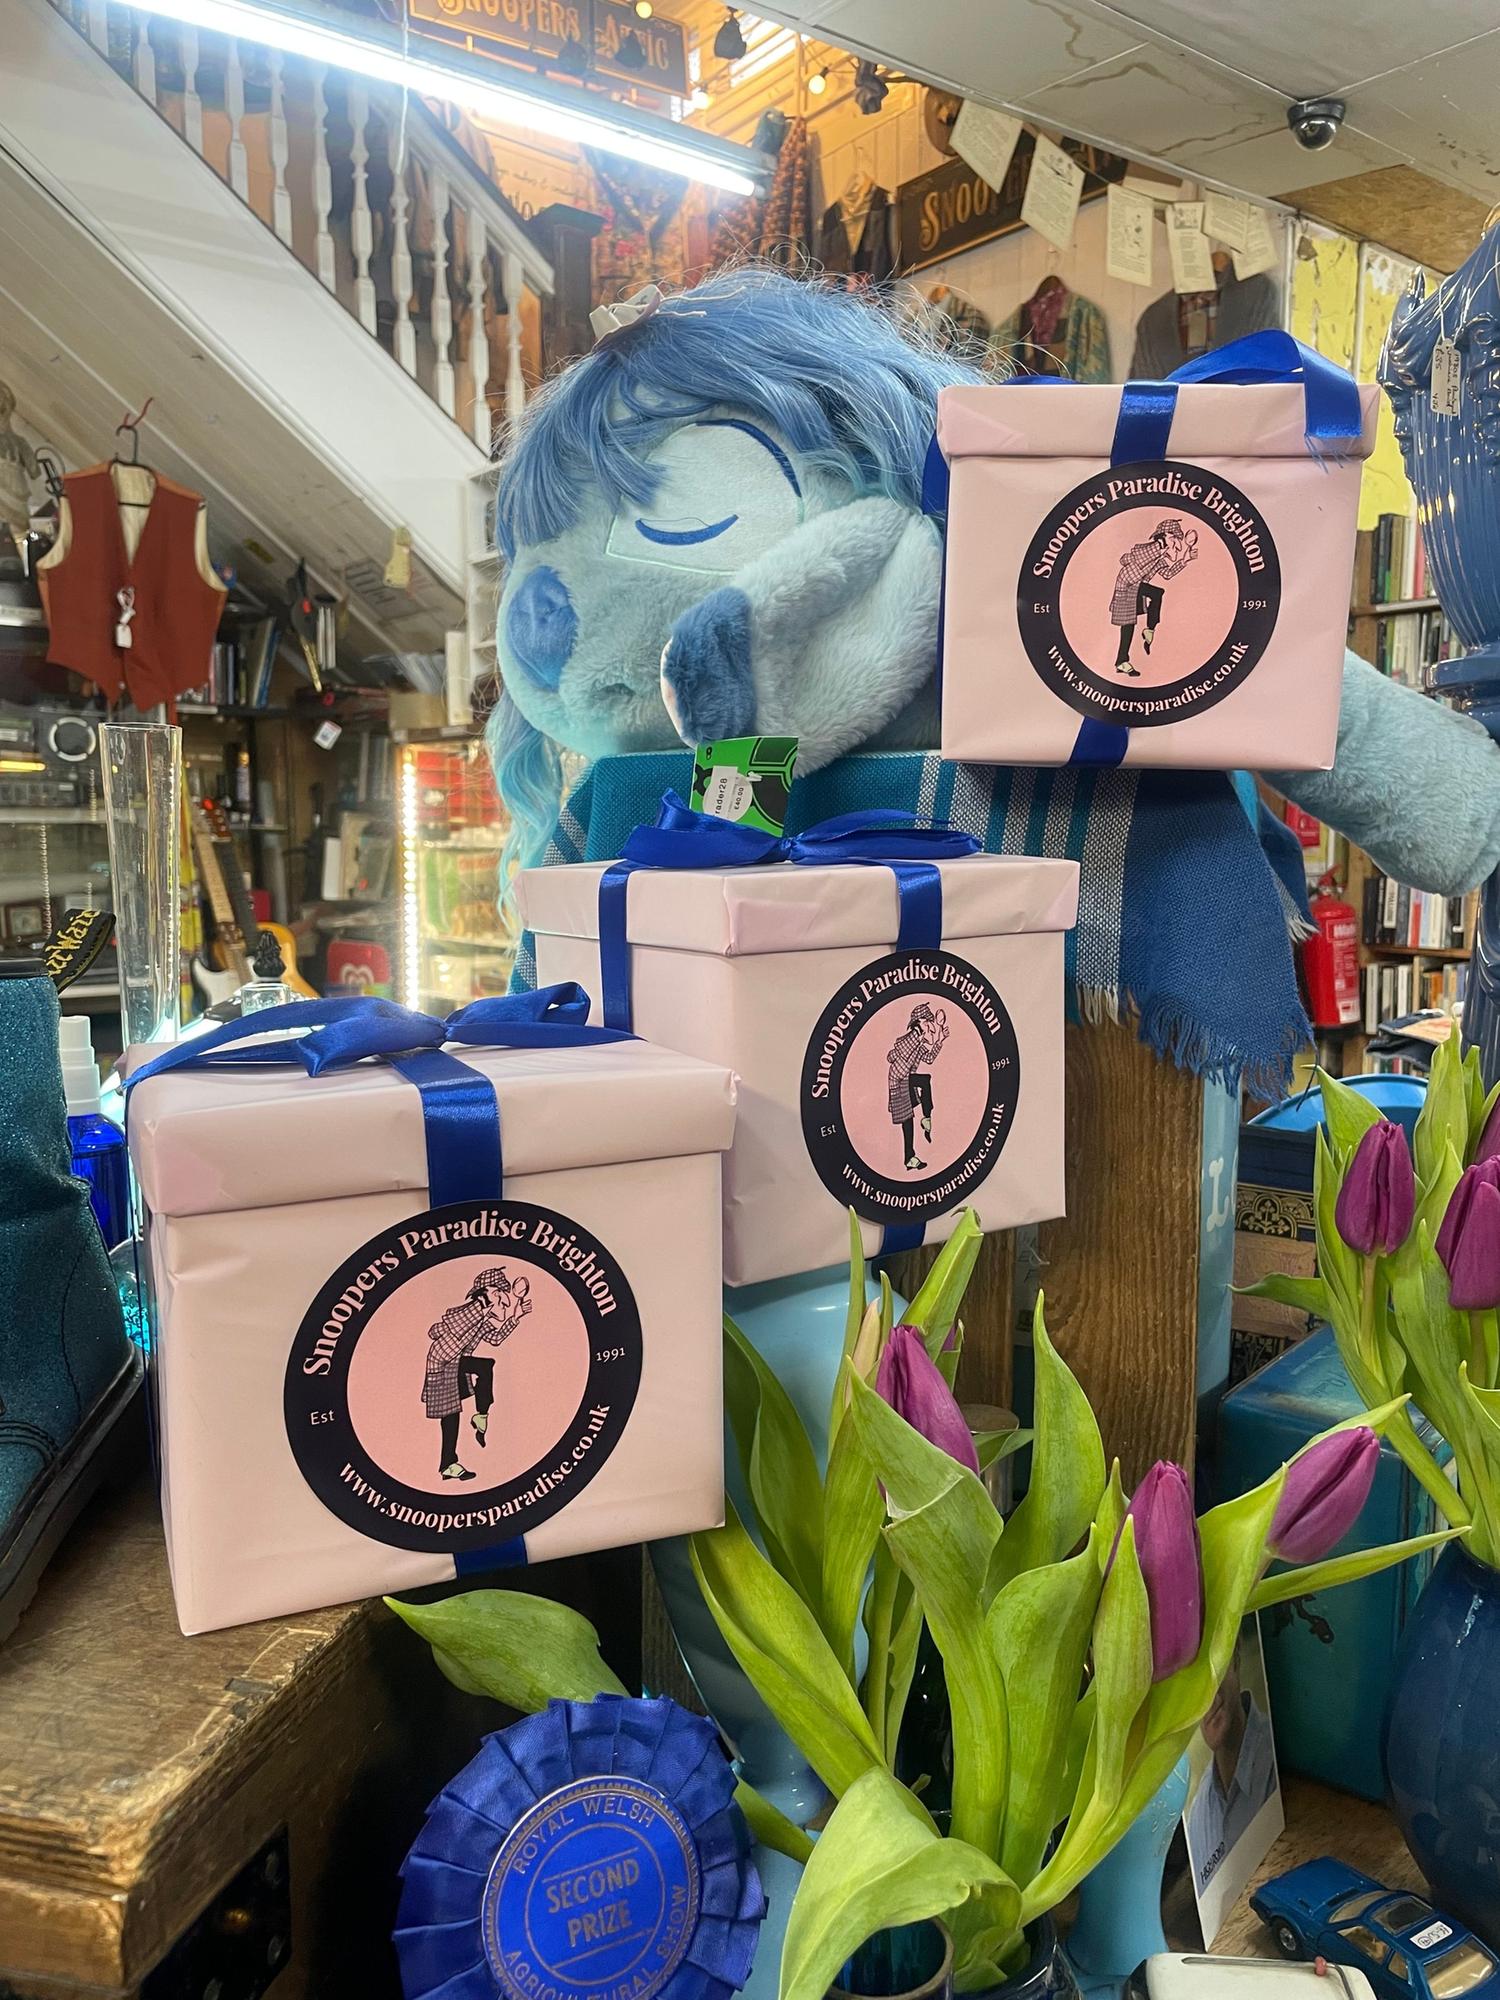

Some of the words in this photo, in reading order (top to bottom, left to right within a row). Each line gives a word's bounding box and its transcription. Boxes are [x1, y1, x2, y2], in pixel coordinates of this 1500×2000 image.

[1032, 491, 1108, 579] Snoopers
[1107, 472, 1202, 501] Paradise
[1202, 487, 1266, 574] Brighton
[1033, 602, 1050, 614] Est
[1242, 599, 1267, 610] 1991
[1047, 641, 1249, 716] www.snoopersparadise.co.uk
[715, 778, 728, 814] rader28
[811, 996, 864, 1099] Snoopers
[859, 958, 939, 1003] Paradise
[942, 963, 1002, 1036] Brighton
[992, 1057, 1010, 1071] 1991
[820, 1124, 836, 1138] Est
[842, 1102, 1005, 1212] www.snoopersparadise.co.uk
[303, 1250, 400, 1376] Snoopers
[398, 1210, 527, 1259] Paradise
[529, 1220, 618, 1318] Brighton
[595, 1346, 626, 1363] 1991
[310, 1409, 335, 1426] Est
[339, 1403, 610, 1533] www.snoopersparadise.co.uk
[512, 1811, 575, 1875] ROYAL
[582, 1797, 656, 1829] WELSH
[545, 1858, 641, 1914] SECOND
[567, 1899, 633, 1948] PRIZE
